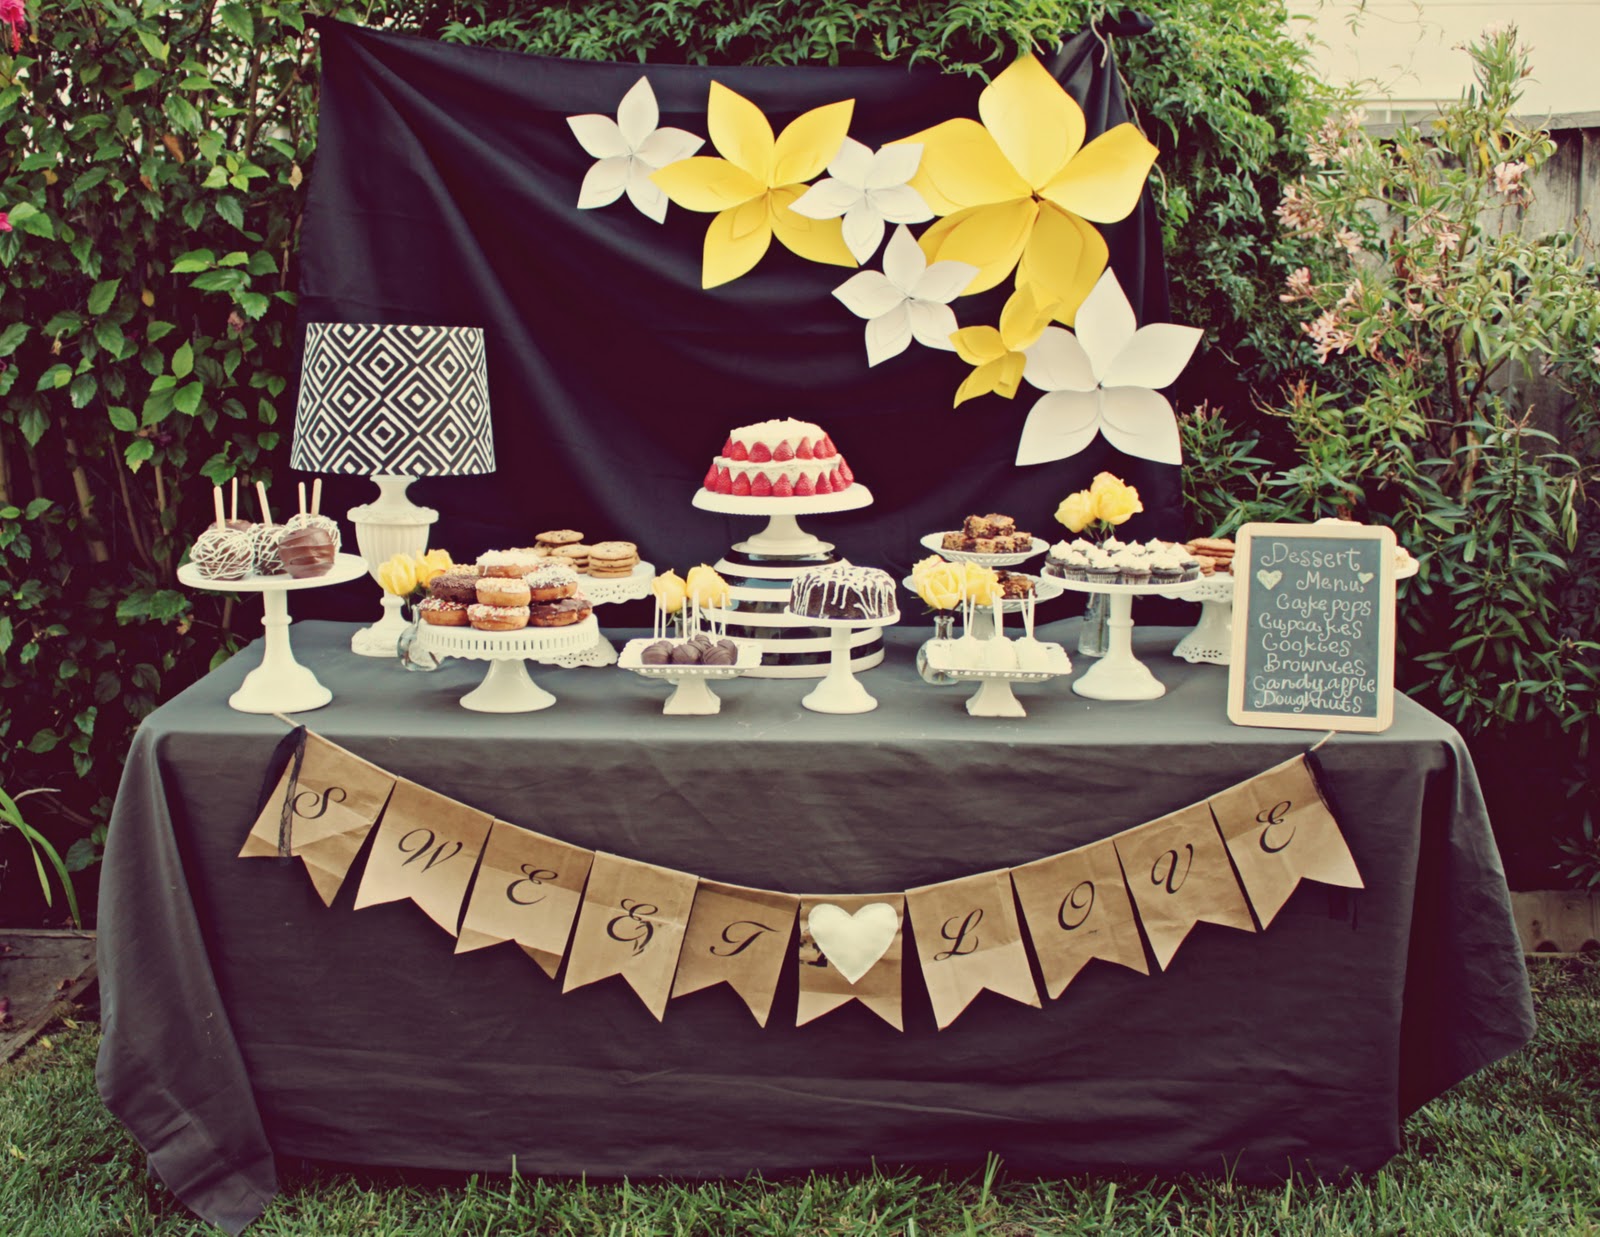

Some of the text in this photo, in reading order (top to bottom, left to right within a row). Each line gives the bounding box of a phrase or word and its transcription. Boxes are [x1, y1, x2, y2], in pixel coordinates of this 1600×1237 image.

[1260, 542, 1361, 571] Dessert
[1296, 571, 1365, 593] Menu
[1276, 593, 1371, 622] Cake pops
[1258, 612, 1362, 641] Cupcakes
[1262, 633, 1351, 657] Cookies
[1263, 653, 1366, 676] Brownies
[1254, 690, 1362, 713] Doughnuts
